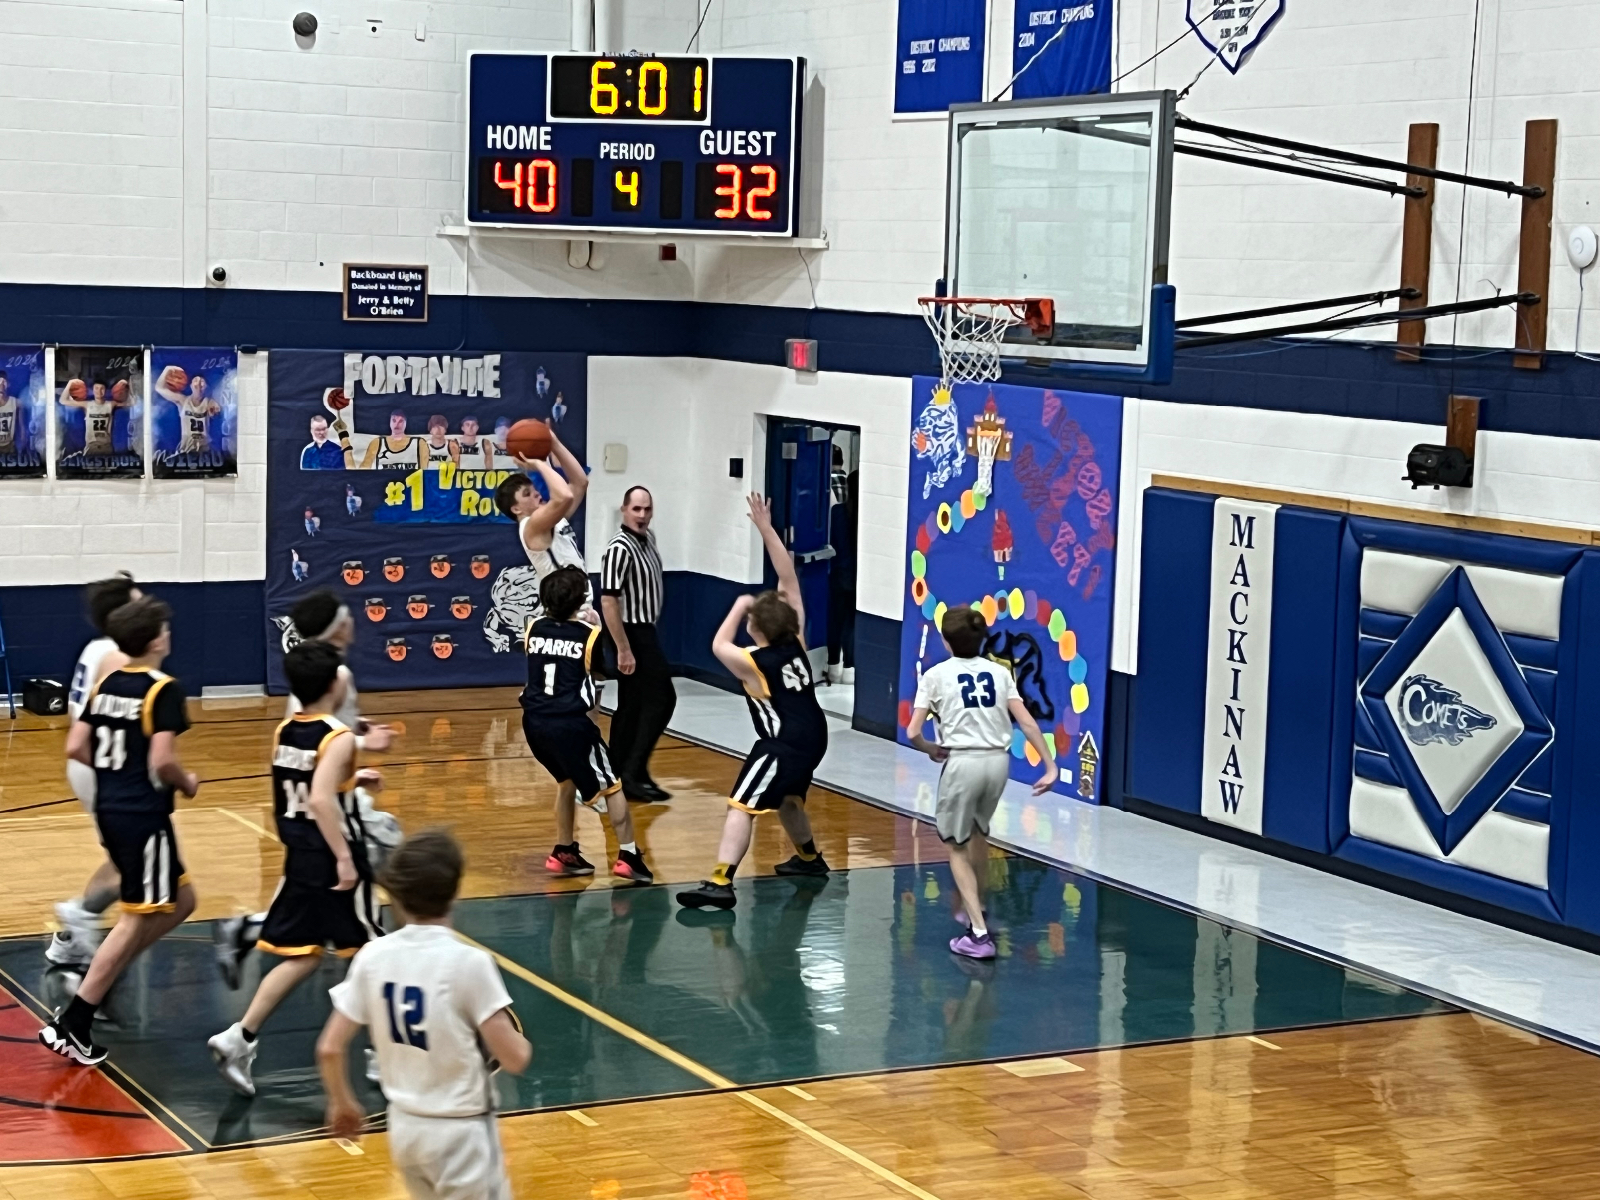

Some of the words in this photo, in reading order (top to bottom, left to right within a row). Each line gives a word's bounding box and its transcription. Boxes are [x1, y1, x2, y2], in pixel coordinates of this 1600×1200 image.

[590, 61, 702, 115] 6:01
[487, 125, 552, 151] HOME
[600, 142, 655, 161] PERIOD
[700, 129, 777, 156] GUEST
[494, 159, 556, 213] 40
[615, 170, 638, 206] 4
[715, 164, 777, 219] 32
[350, 270, 396, 280] Backboard
[398, 271, 422, 282] Lights
[388, 284, 412, 292] Memory
[358, 295, 379, 305] Jerry
[382, 296, 390, 304] &
[370, 306, 404, 315] O'Brien
[344, 352, 501, 399] FORTNITE
[93, 419, 106, 431] 22
[384, 469, 424, 511] #1
[438, 461, 513, 490] VICTOR
[528, 636, 583, 659] SPARKS
[544, 663, 556, 695] 1
[1218, 513, 1256, 815] MACKINAW
[957, 671, 996, 708] 23
[383, 982, 430, 1052] 12
